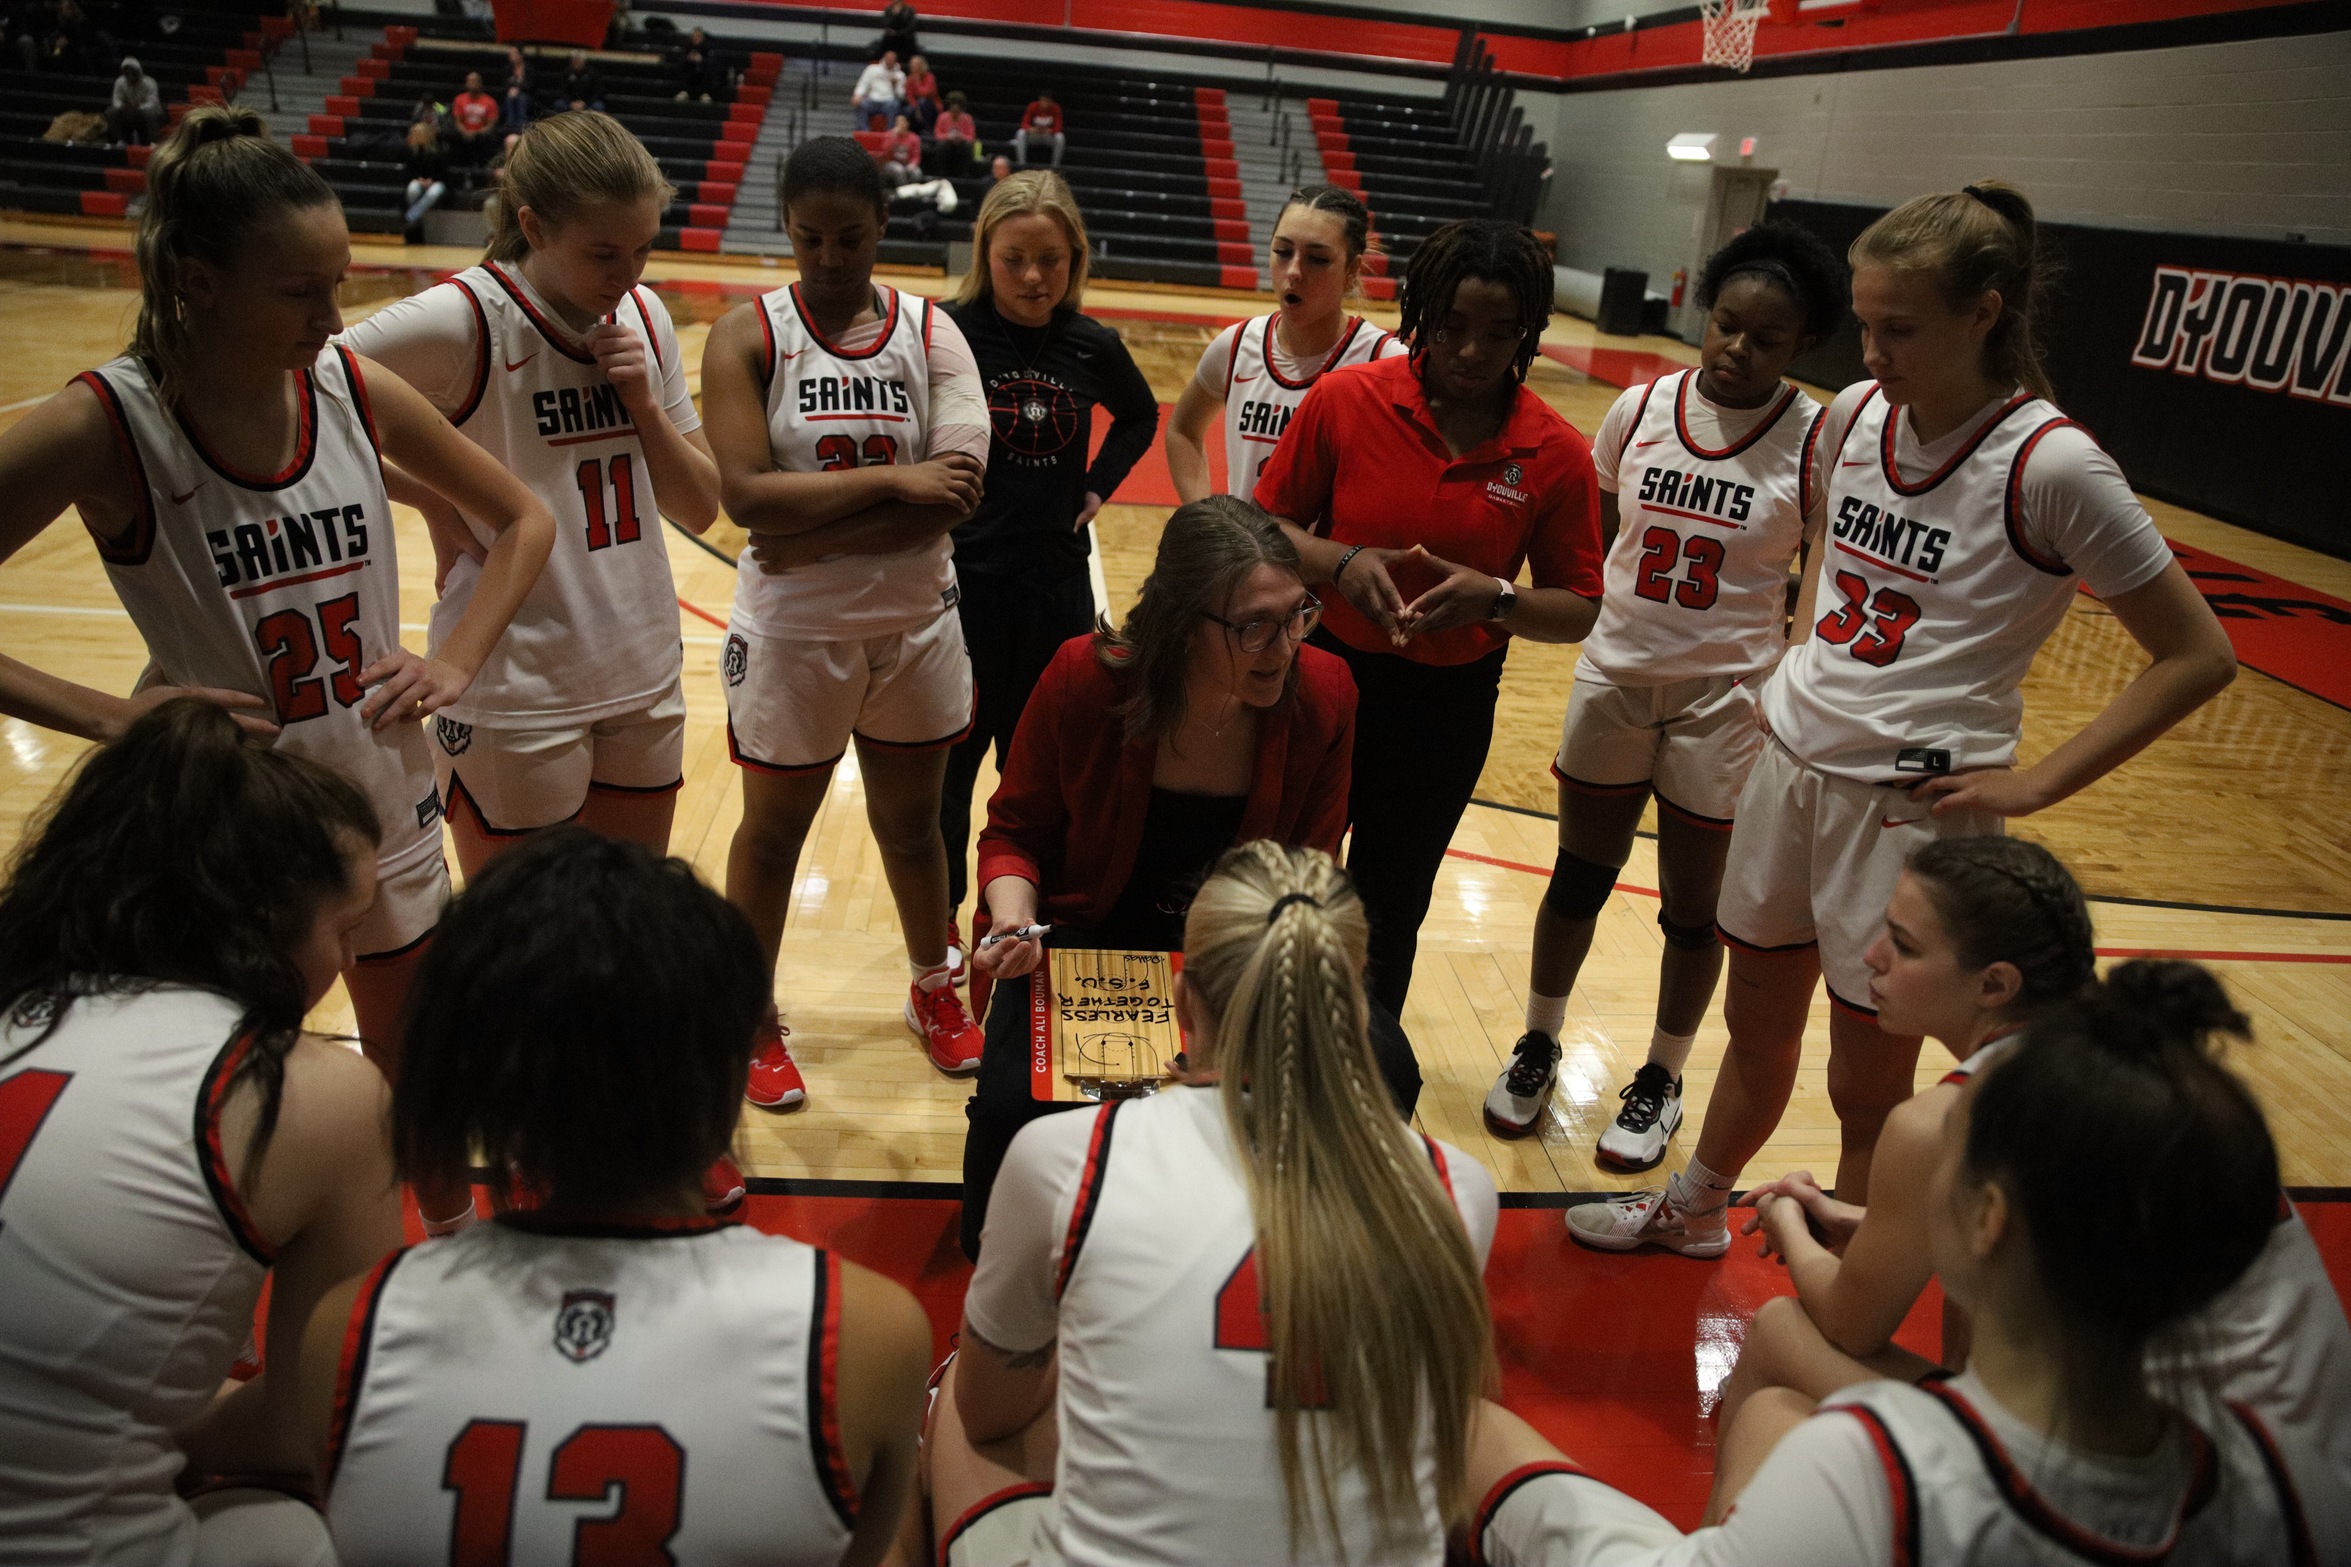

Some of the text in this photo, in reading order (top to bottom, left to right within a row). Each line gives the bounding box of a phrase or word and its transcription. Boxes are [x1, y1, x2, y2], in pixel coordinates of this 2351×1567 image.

[2131, 264, 2351, 408] D'YOUV
[576, 453, 641, 552] 11
[1634, 525, 1726, 611] 23
[254, 591, 365, 726] 25
[1816, 568, 1921, 668] 33
[1933, 756, 1940, 767] L
[1034, 970, 1047, 1073] COACH ALI BOUMAN
[1057, 992, 1175, 1009] TOGETHER
[1061, 1009, 1170, 1024] FEARLESS
[441, 1417, 687, 1567] 13
